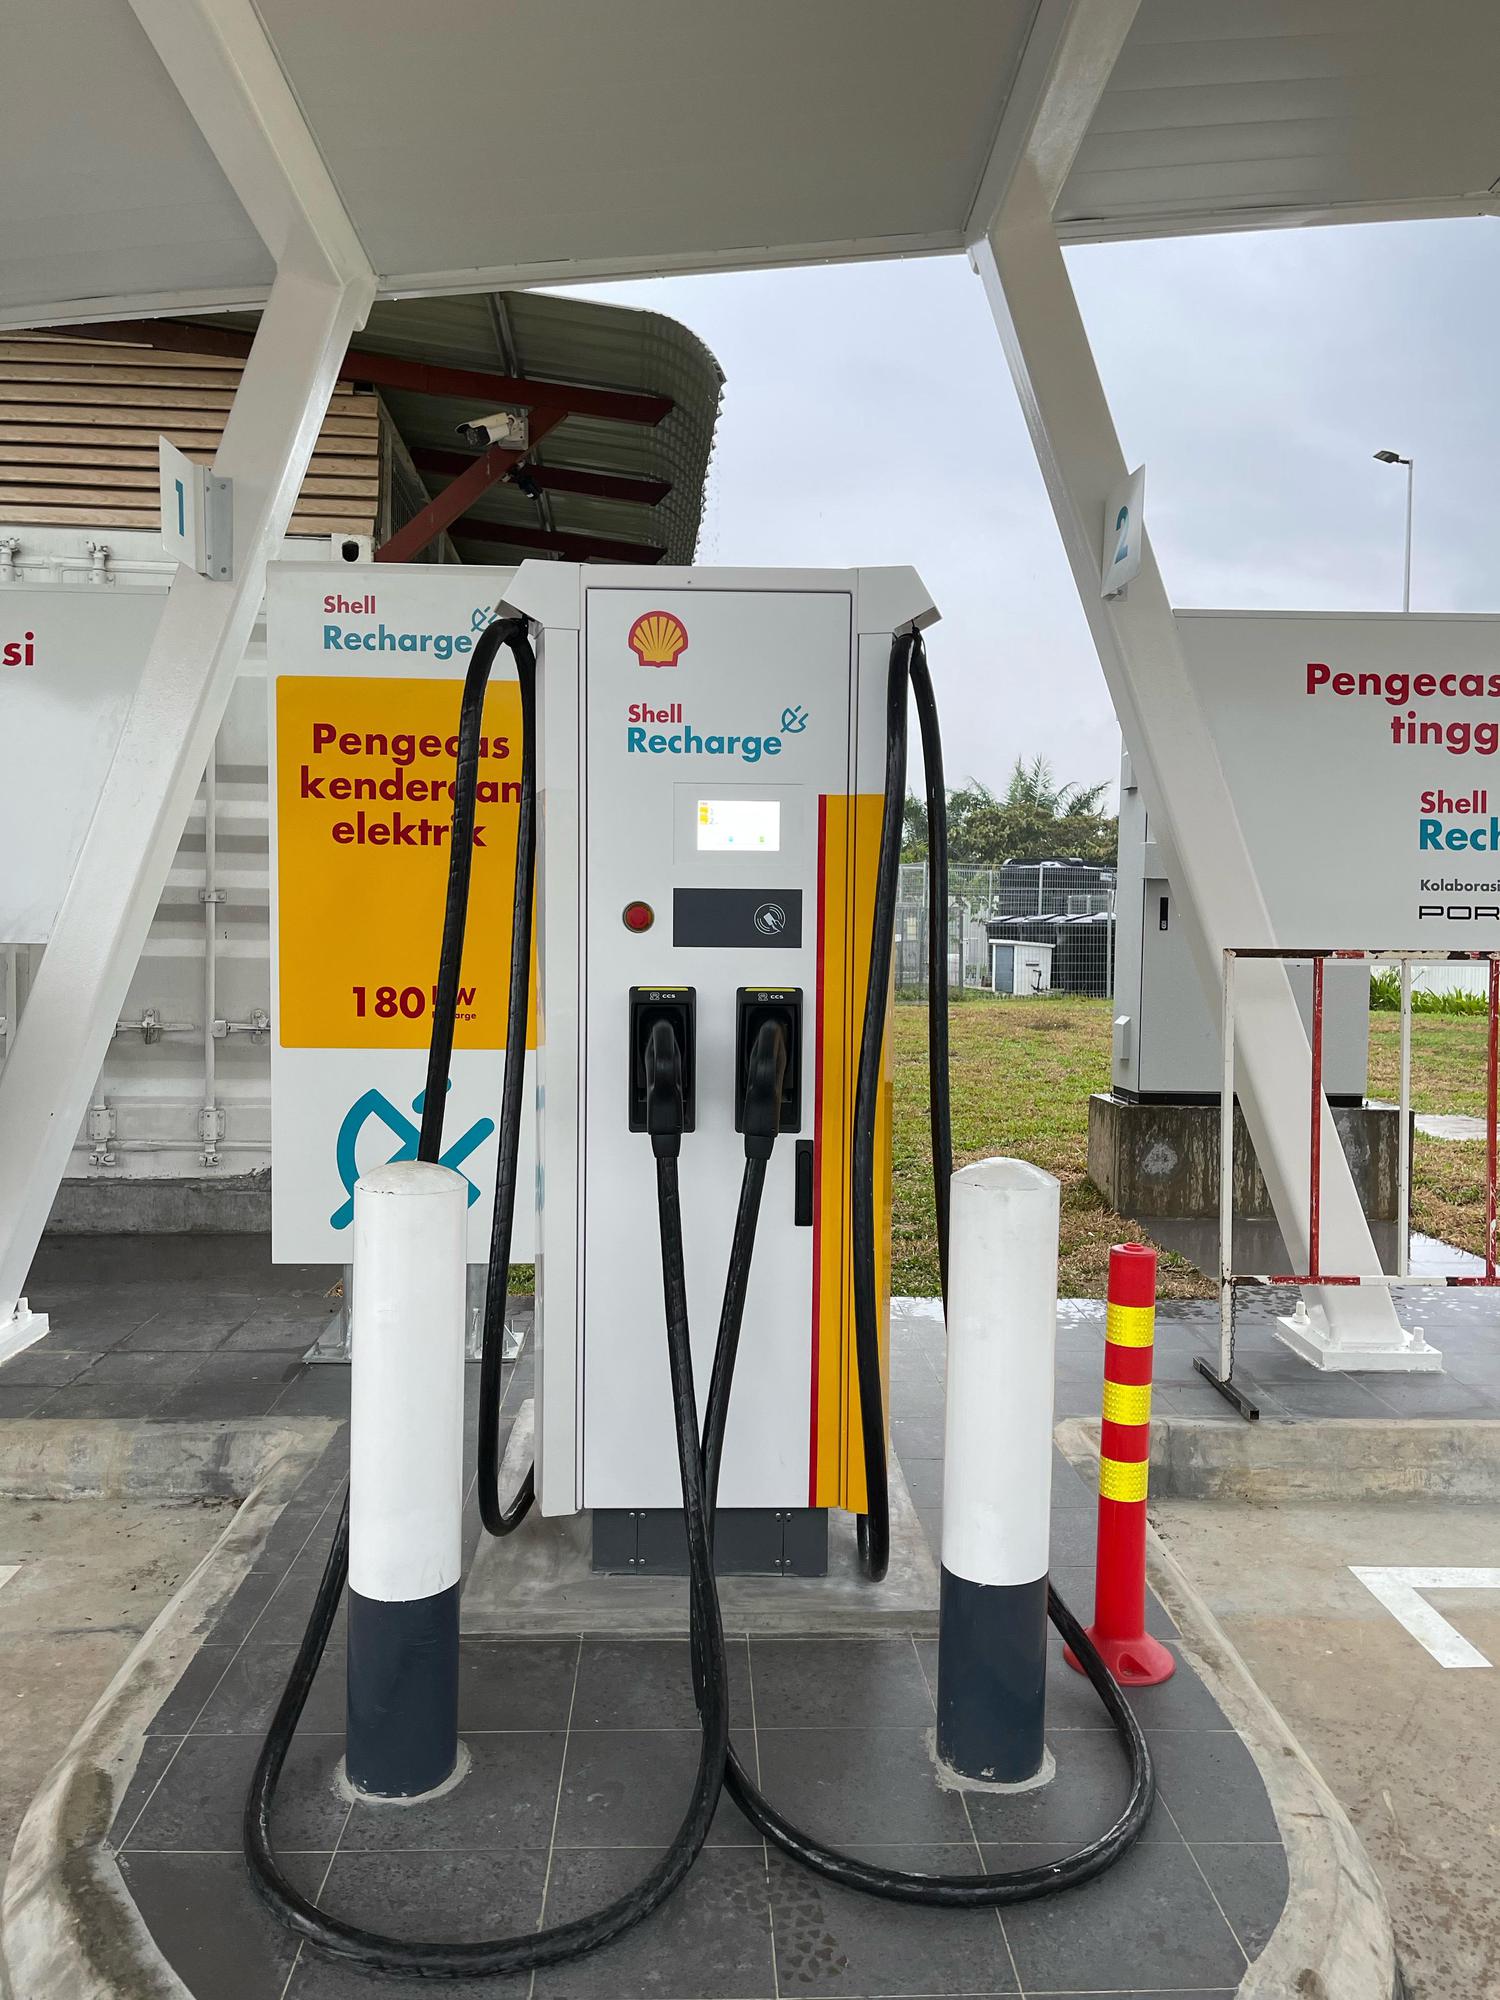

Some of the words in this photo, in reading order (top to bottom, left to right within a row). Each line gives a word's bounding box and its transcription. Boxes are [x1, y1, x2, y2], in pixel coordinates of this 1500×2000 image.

[175, 479, 184, 537] 1
[1114, 505, 1129, 565] 2
[323, 594, 376, 614] Shell
[323, 624, 473, 660] Recharge
[1306, 663, 1500, 706] Pengecas
[627, 703, 682, 724] Shell
[627, 726, 782, 763] Recharge
[1420, 790, 1487, 814] Shell
[332, 811, 488, 848] elektr
[1420, 879, 1500, 892] Kolaborasi
[353, 986, 426, 1019] 180
